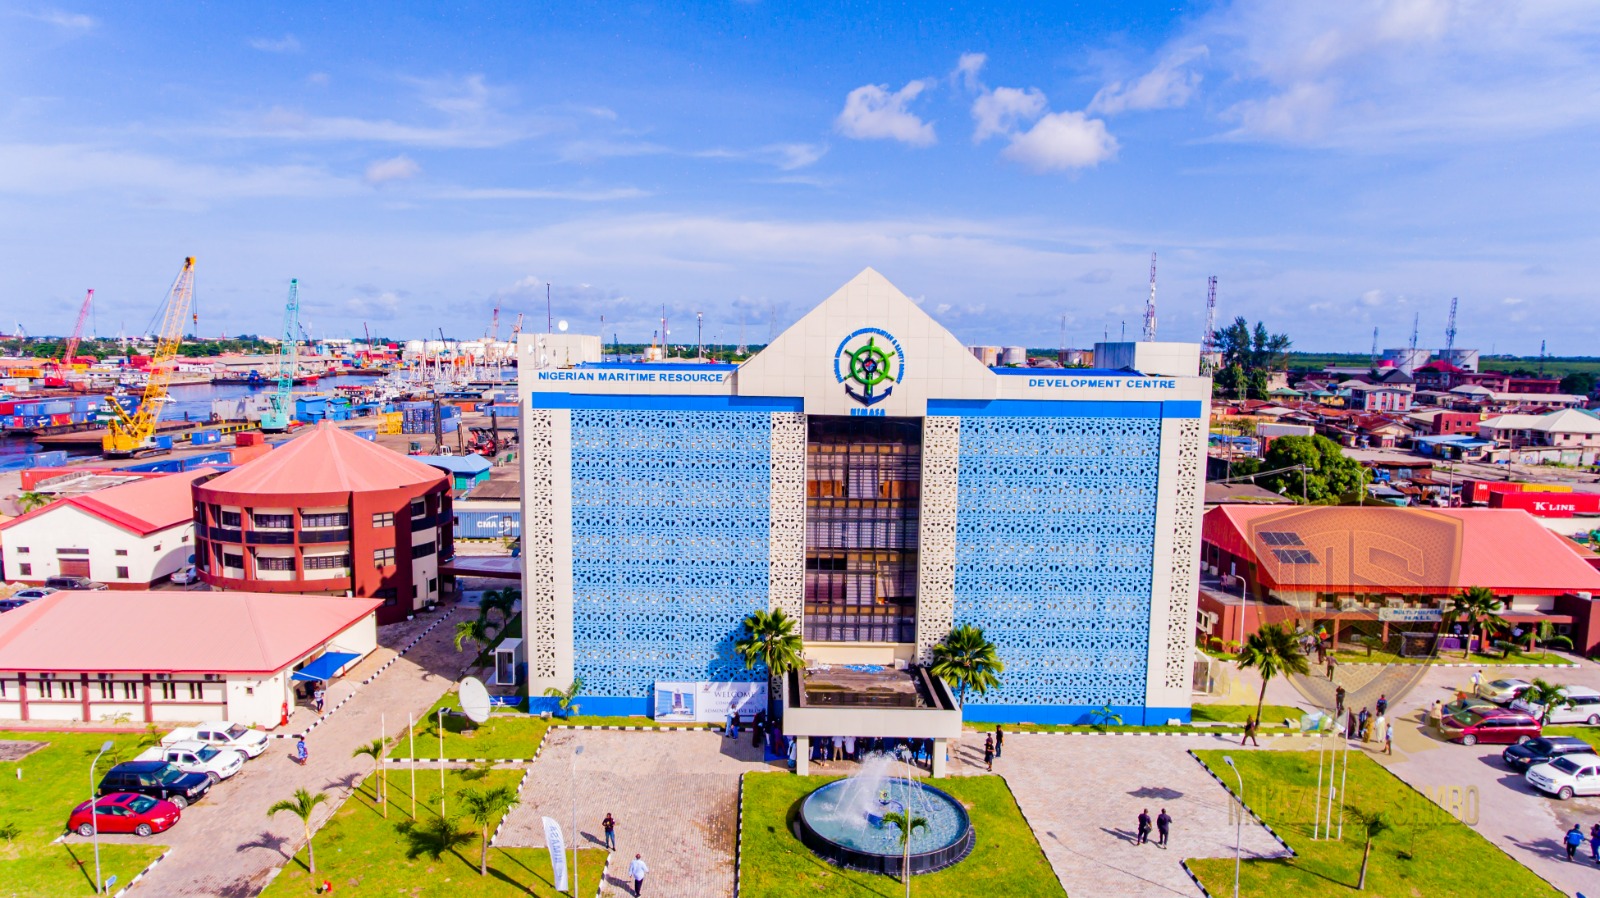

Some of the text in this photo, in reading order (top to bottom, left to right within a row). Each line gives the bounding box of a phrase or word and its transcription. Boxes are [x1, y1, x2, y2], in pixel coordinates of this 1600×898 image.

[538, 371, 723, 383] NIGERIAN MARITIME RESOURCE
[1028, 379, 1176, 389] DEVELOPMENT CENTRE
